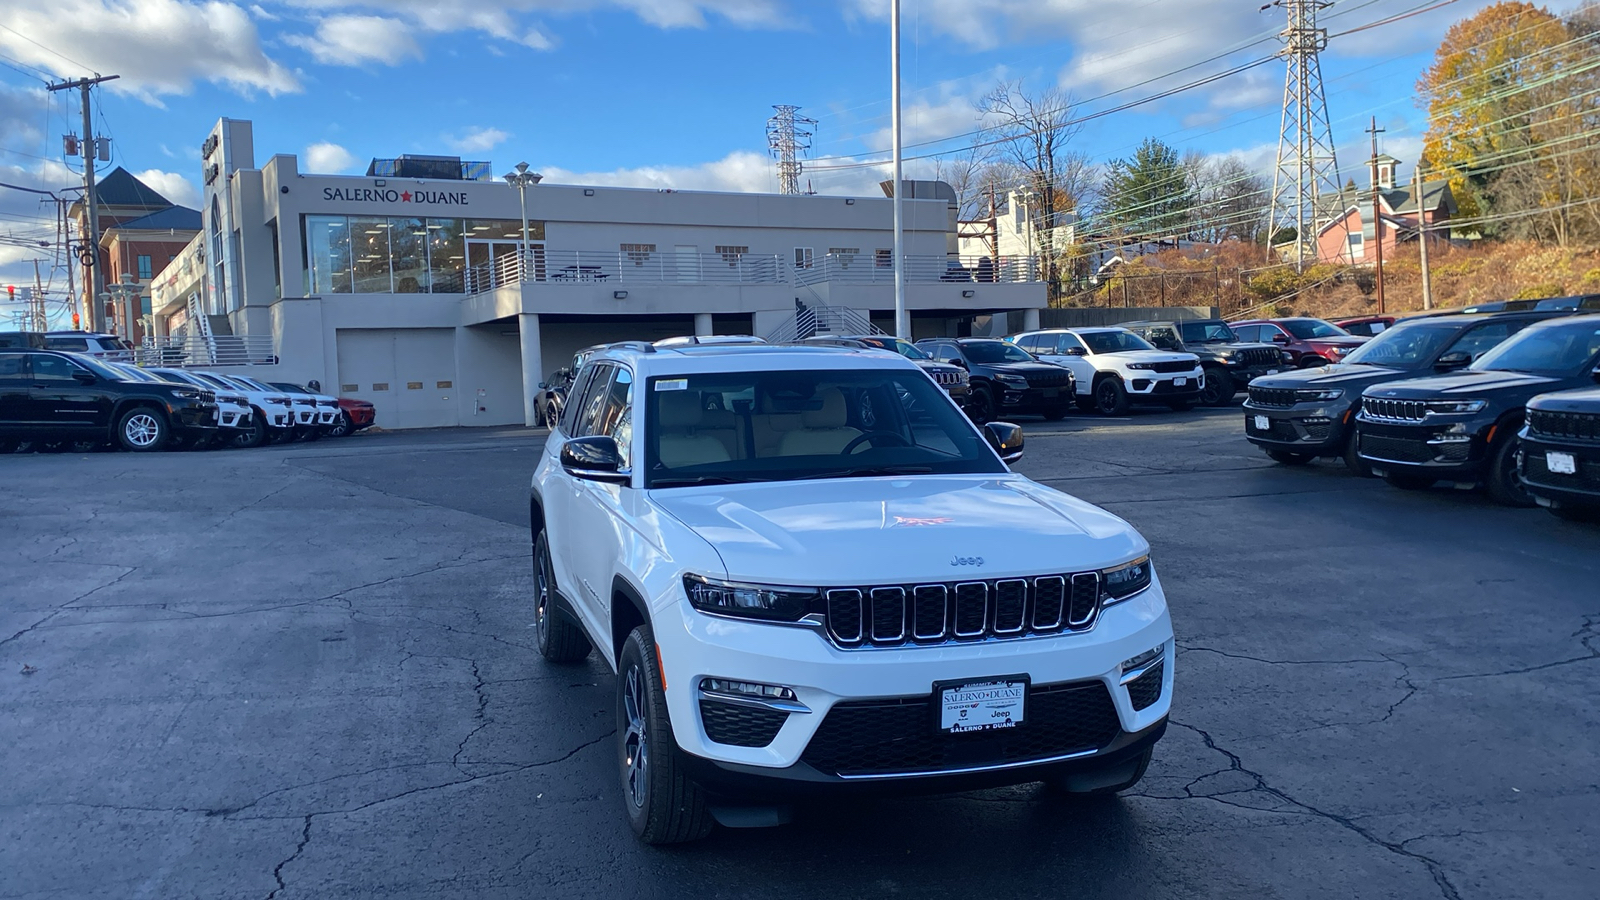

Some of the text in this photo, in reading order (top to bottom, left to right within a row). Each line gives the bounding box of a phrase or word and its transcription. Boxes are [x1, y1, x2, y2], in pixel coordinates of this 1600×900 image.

[323, 187, 469, 205] SALERNO DUANE
[949, 555, 985, 568] Jeep
[944, 691, 985, 703] SALERNO
[990, 688, 1022, 699] DUANE
